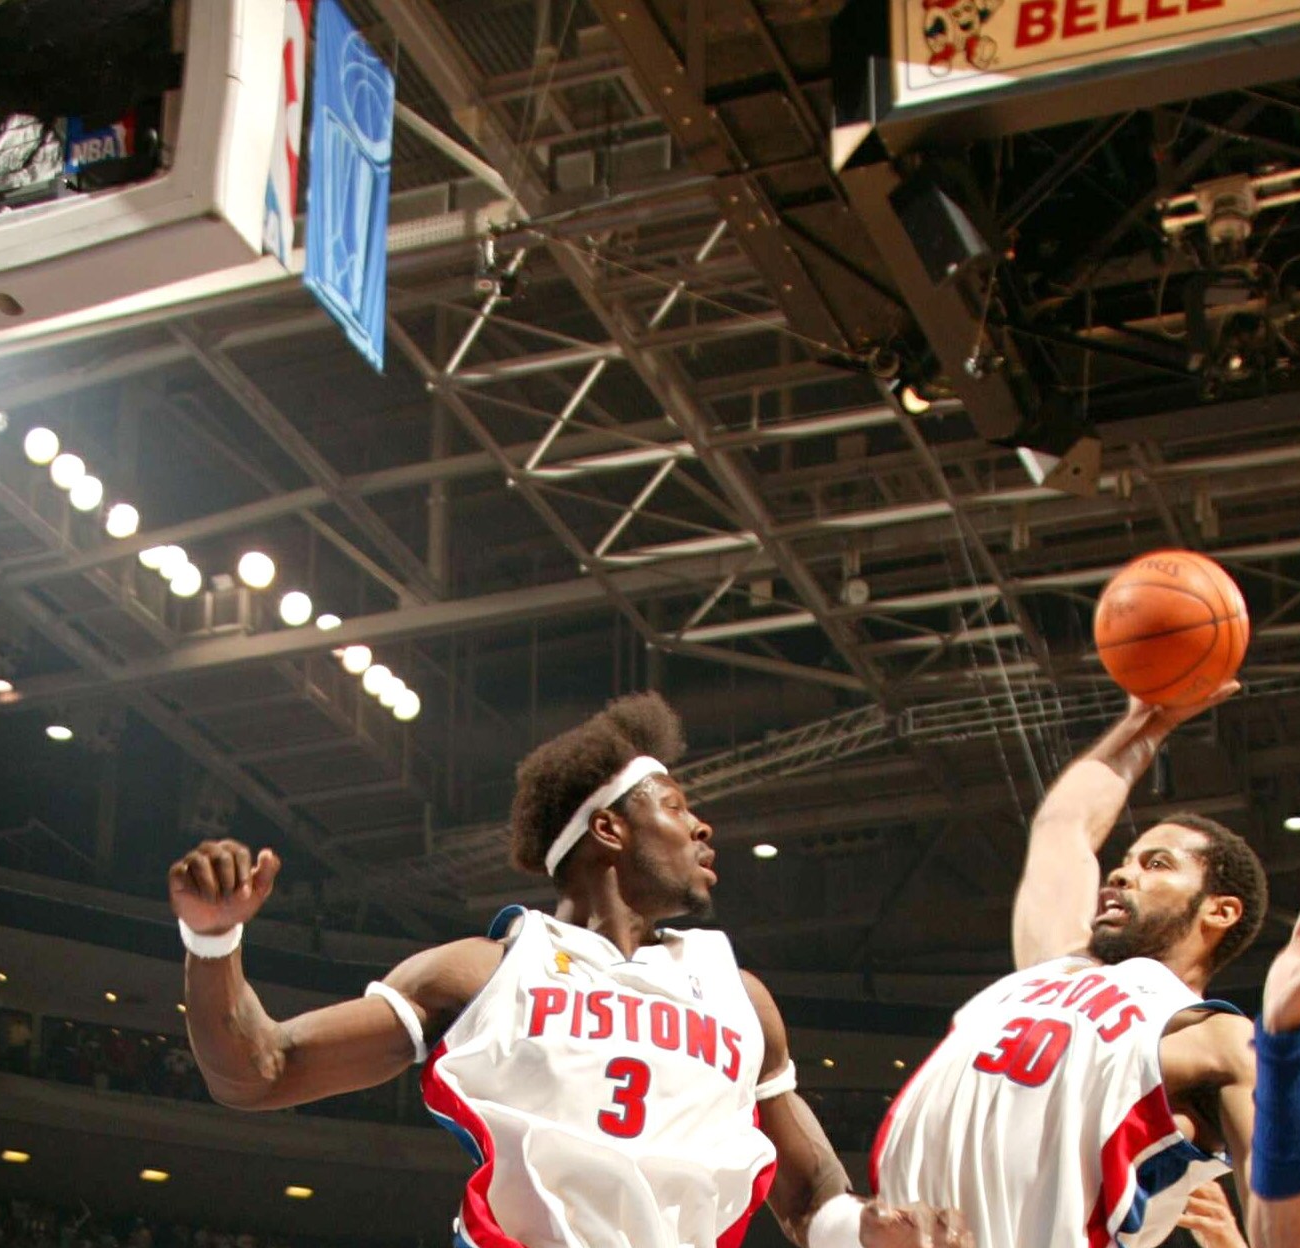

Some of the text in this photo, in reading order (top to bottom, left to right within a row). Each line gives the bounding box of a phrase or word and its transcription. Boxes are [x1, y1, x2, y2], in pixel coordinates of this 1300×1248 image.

[71, 135, 117, 167] NBA
[528, 986, 742, 1083] PISTONS
[973, 1016, 1073, 1088] 30
[597, 1056, 651, 1139] 3
